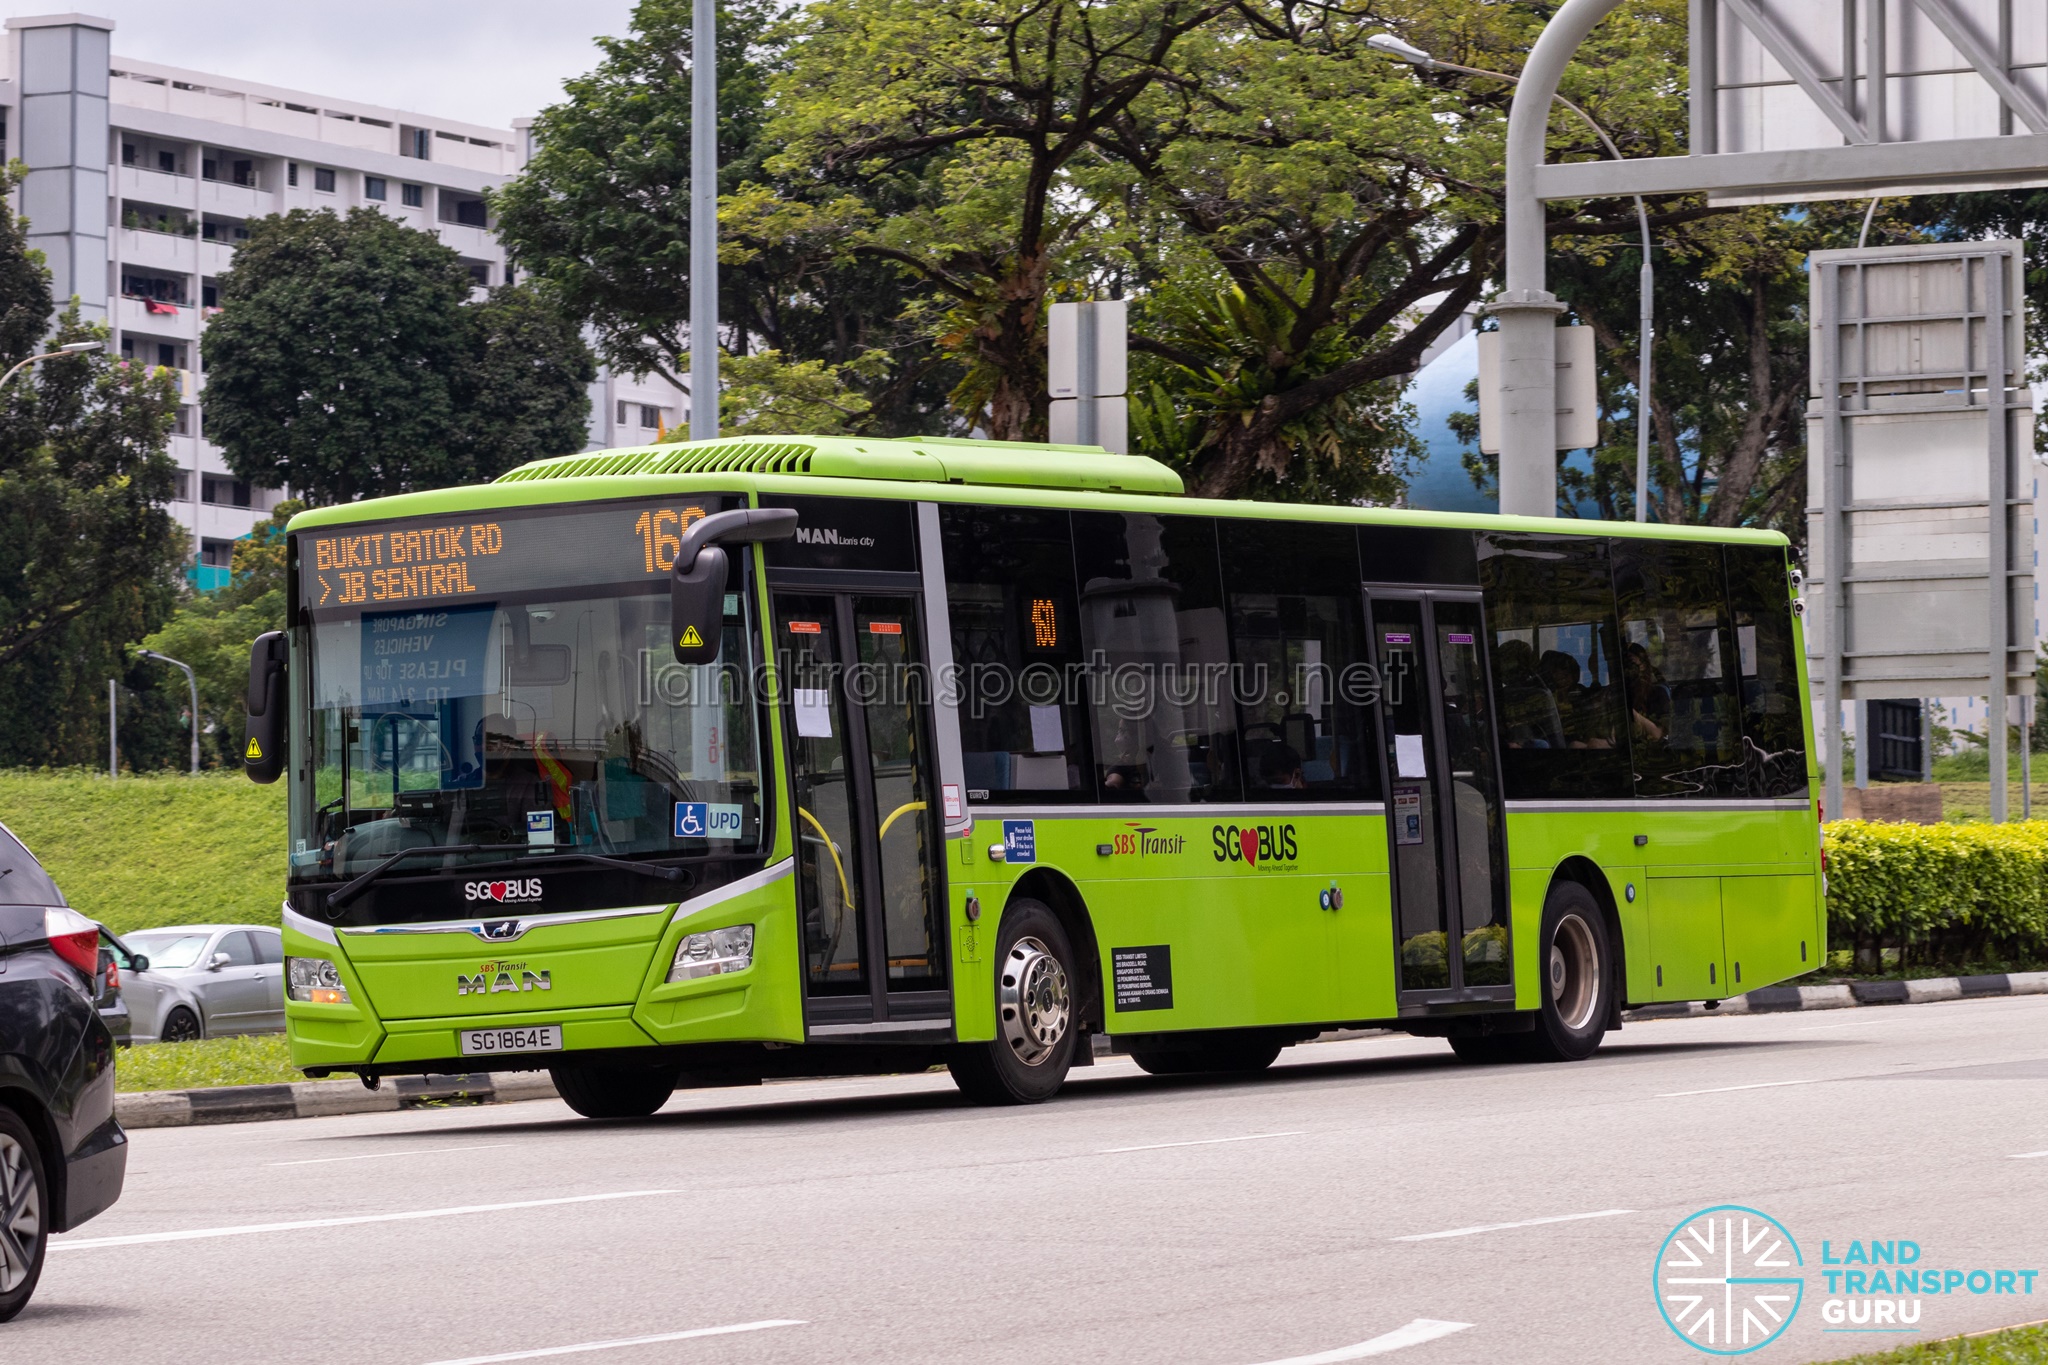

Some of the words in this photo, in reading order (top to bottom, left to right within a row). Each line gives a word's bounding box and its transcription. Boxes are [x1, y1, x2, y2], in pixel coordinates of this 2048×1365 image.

[316, 533, 384, 570] BUKIT
[390, 526, 466, 563] BATOK
[471, 523, 502, 556] RD
[635, 507, 706, 573] 16
[796, 527, 839, 545] MAN
[860, 536, 875, 547] City
[338, 571, 366, 603] JB
[372, 561, 476, 600] SENTRAL
[709, 812, 740, 830] UPD
[1114, 834, 1136, 855] SBS
[1133, 827, 1187, 859] Transit
[480, 964, 495, 973] SBS
[496, 960, 528, 972] Transit
[457, 970, 551, 995] MAN
[471, 1029, 551, 1050] SG1864E
